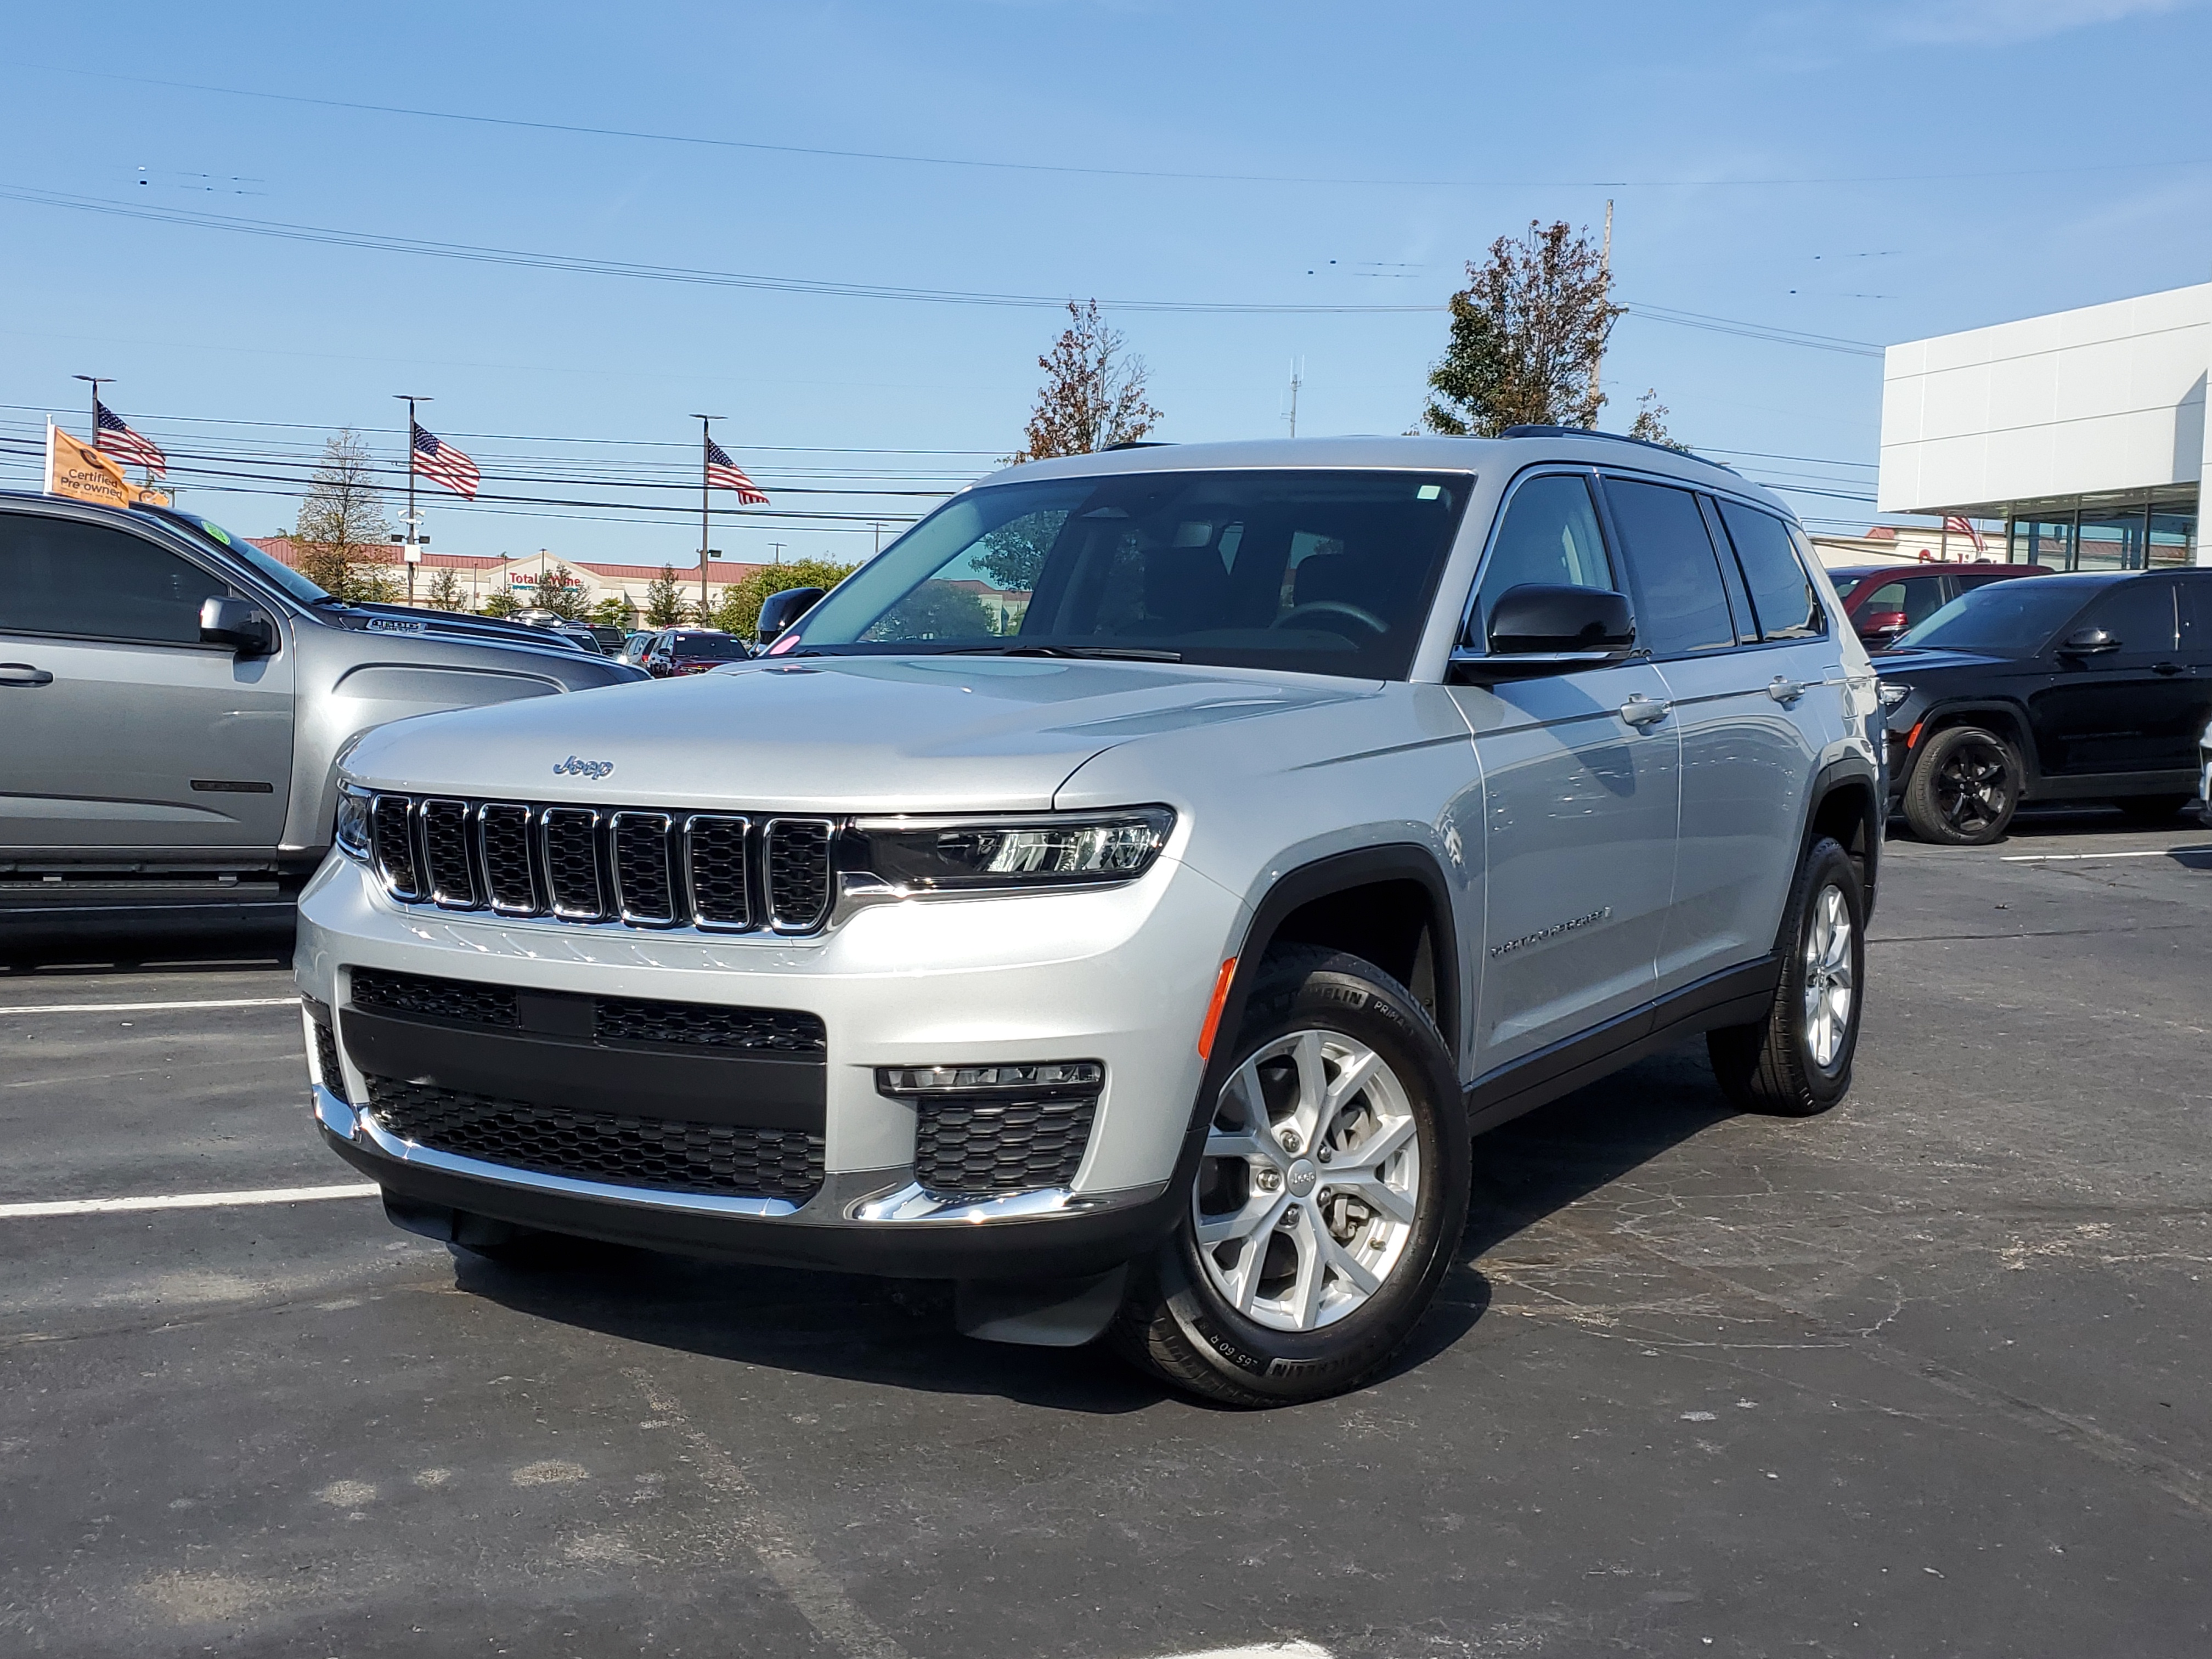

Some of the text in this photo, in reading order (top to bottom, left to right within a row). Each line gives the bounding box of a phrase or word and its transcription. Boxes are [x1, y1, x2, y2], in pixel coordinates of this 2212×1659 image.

[60, 476, 81, 489] Pre
[83, 483, 122, 499] owned
[68, 469, 119, 488] Certified
[509, 572, 538, 584] Total
[553, 755, 613, 780] Jeep
